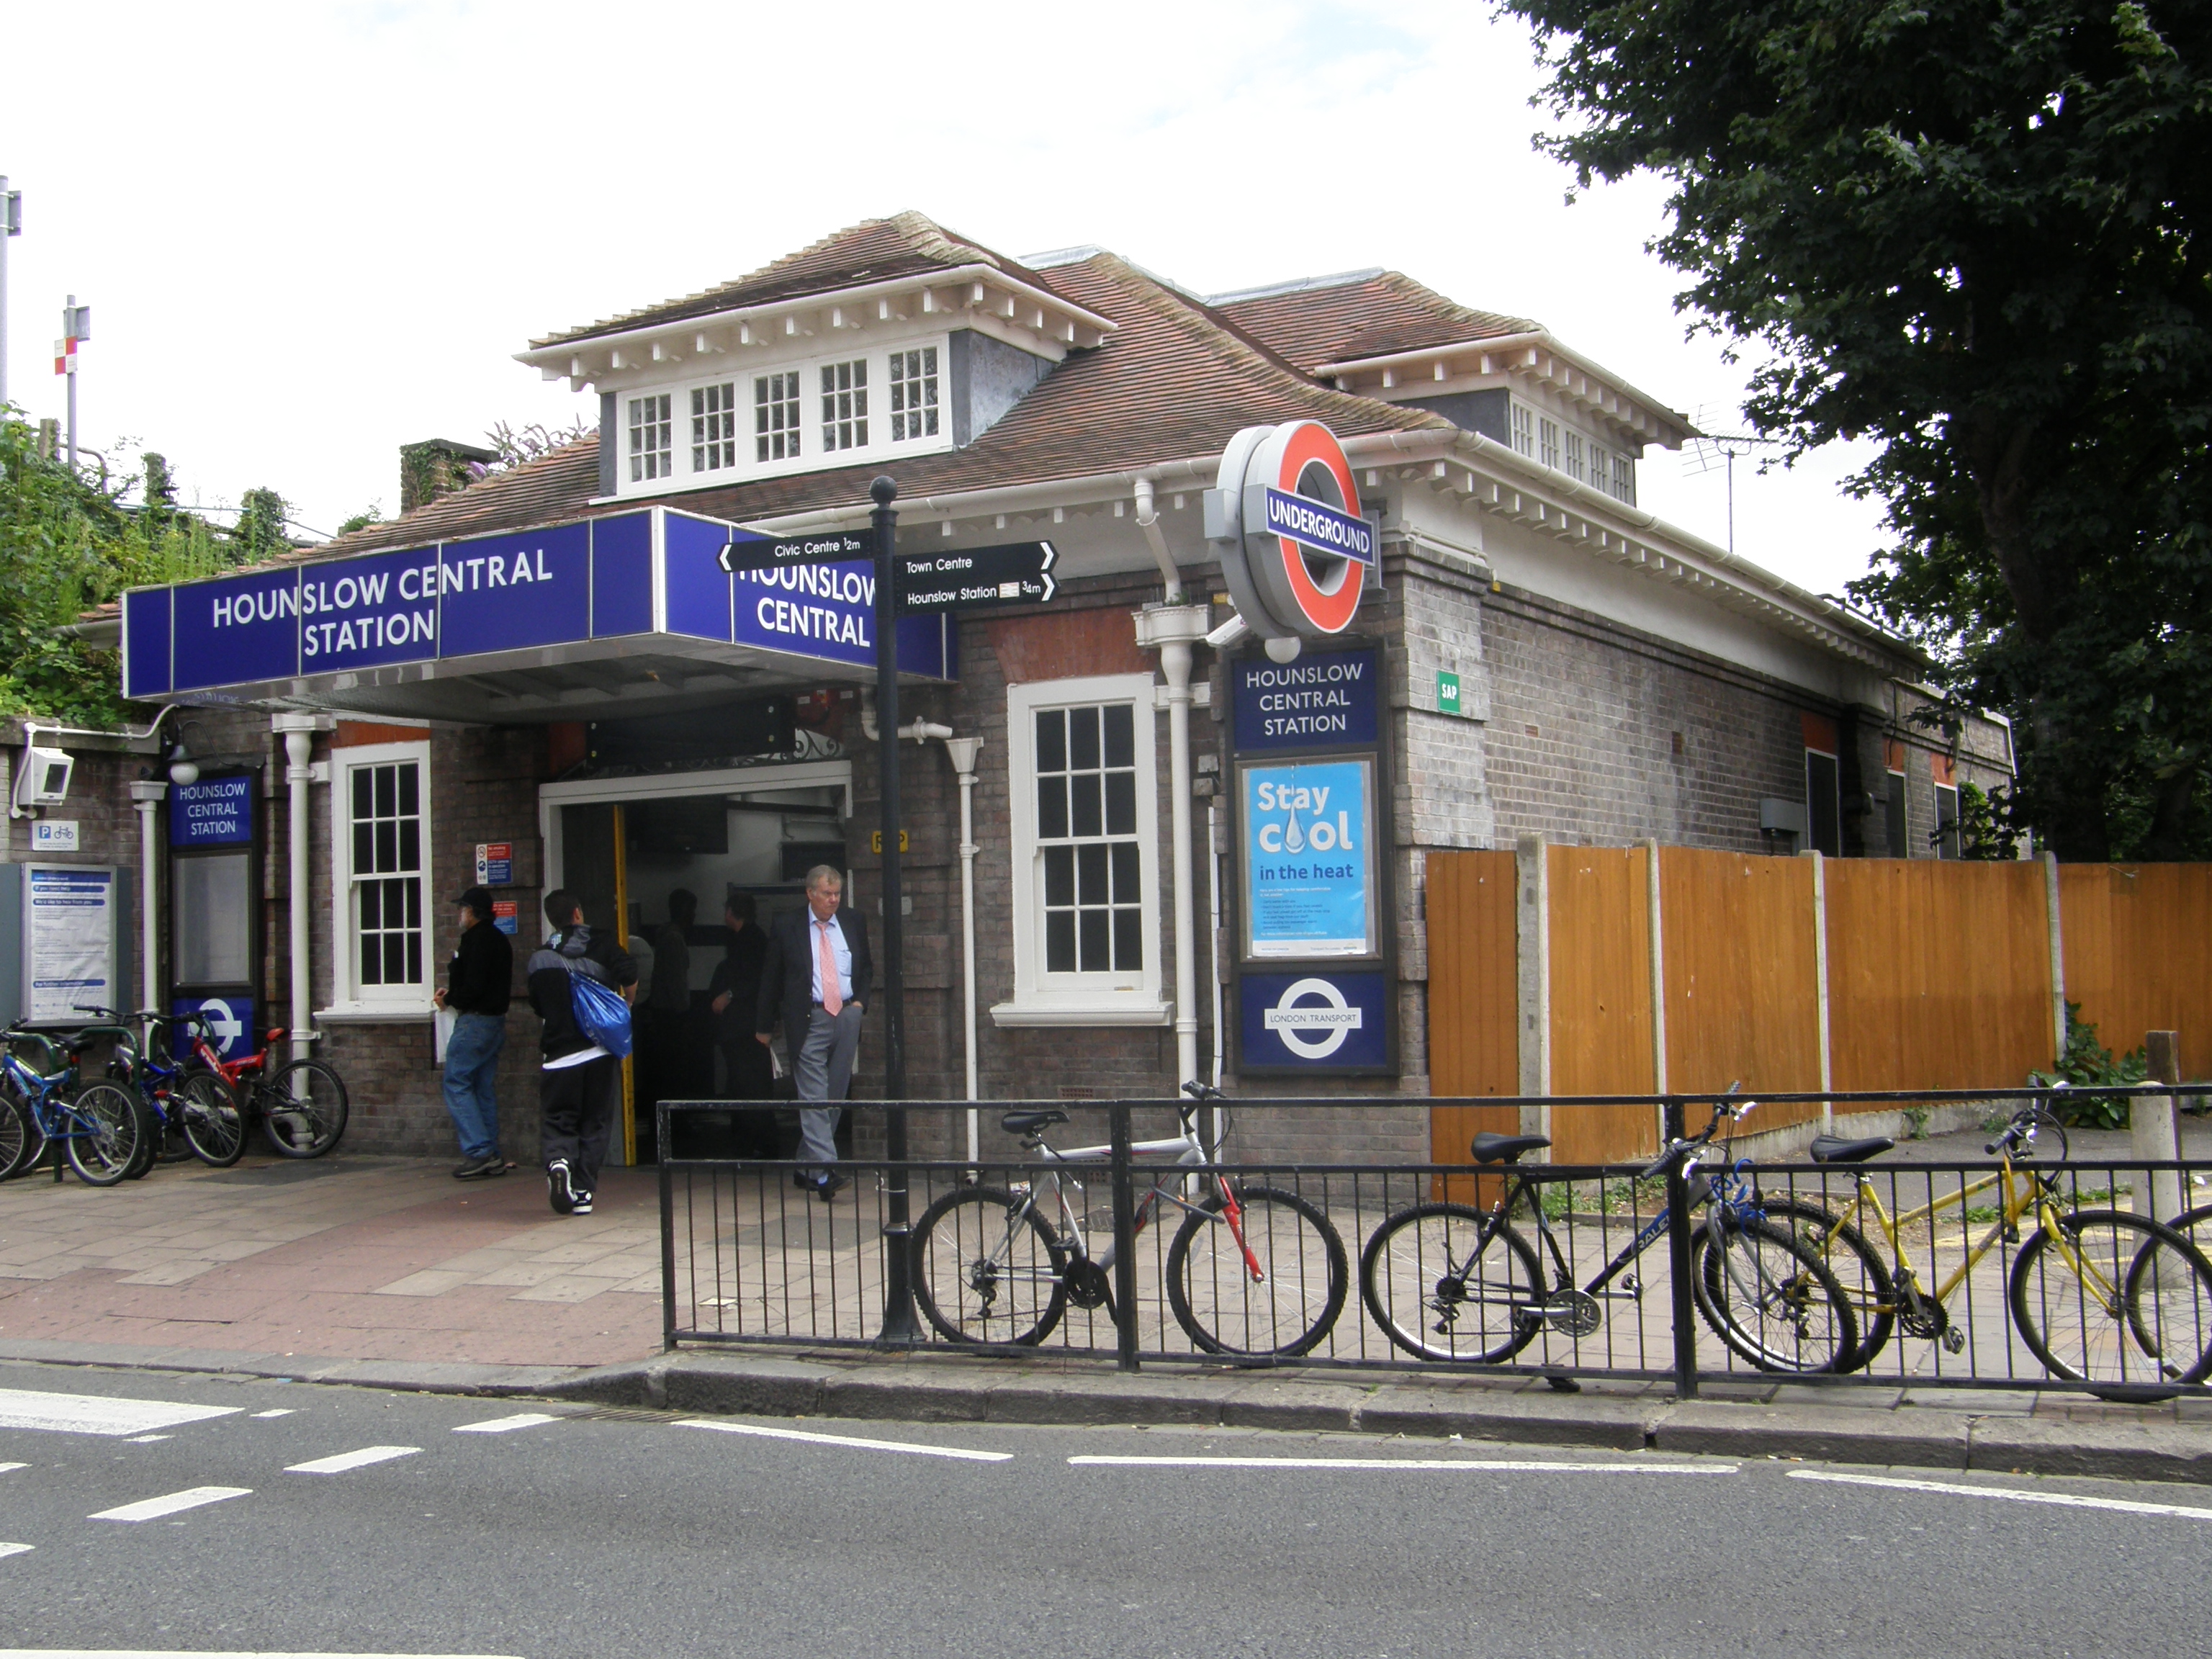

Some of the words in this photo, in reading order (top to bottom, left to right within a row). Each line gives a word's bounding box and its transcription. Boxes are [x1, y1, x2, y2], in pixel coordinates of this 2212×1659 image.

[1269, 497, 1370, 554] UNDERGROUND
[775, 544, 800, 558] Civic
[805, 540, 840, 555] Centre
[907, 560, 932, 574] Town
[936, 557, 973, 571] Centre
[213, 572, 389, 628] HOUNSLOW
[399, 549, 552, 601] CENTRAL
[907, 589, 956, 606] Hounslow
[960, 585, 997, 601] Station
[757, 597, 871, 647] CENTRAL
[305, 609, 435, 656] STATION
[1246, 663, 1363, 689] HOUNSLOW
[1259, 690, 1350, 711] CENTRAL
[1442, 683, 1457, 700] SAP
[1264, 714, 1346, 736] STATION
[179, 783, 246, 800] HOUNSLOW
[1257, 782, 1330, 816] Stay
[188, 801, 238, 817] CENTRAL
[42, 827, 49, 838] P
[191, 820, 236, 835] STATION
[1260, 866, 1274, 880] in
[1279, 864, 1308, 879] the
[1313, 863, 1354, 878] heat
[1270, 1013, 1306, 1023] LONDON
[1310, 1013, 1357, 1023] TRANSPORT
